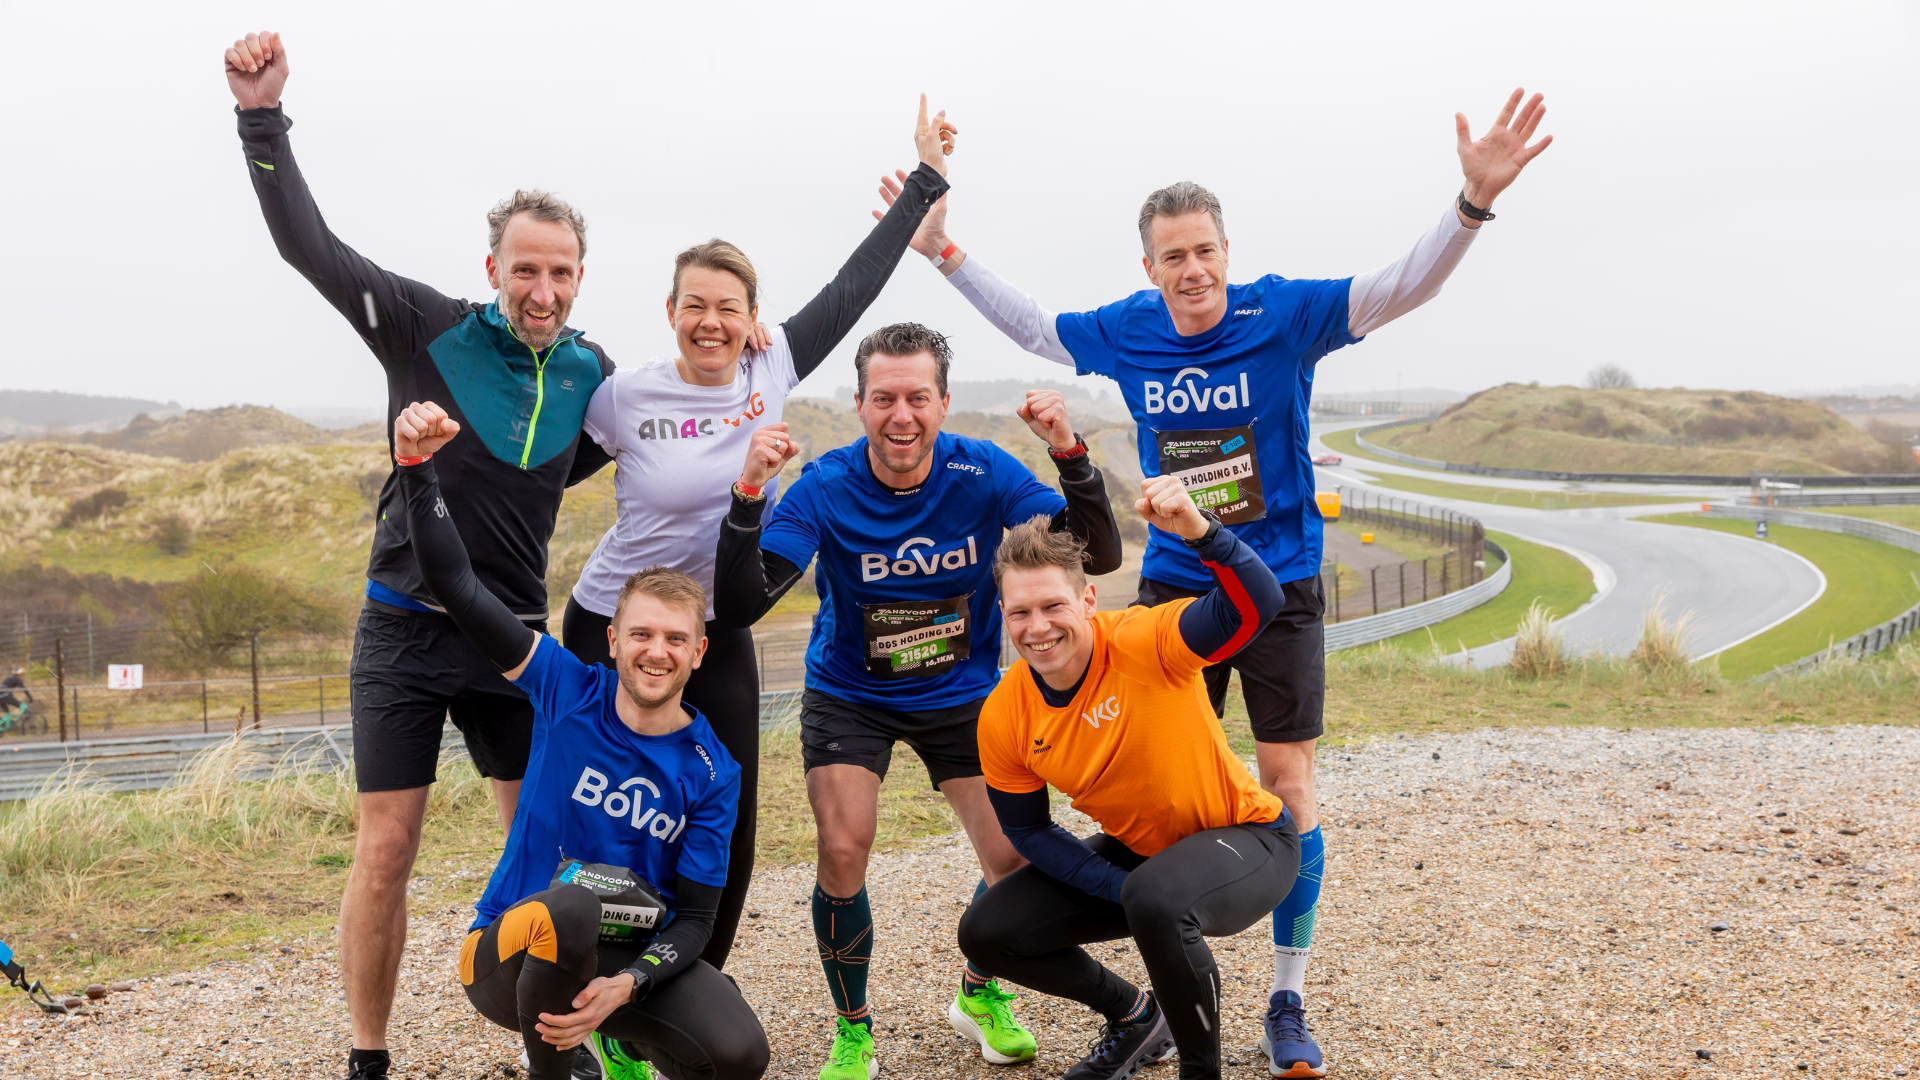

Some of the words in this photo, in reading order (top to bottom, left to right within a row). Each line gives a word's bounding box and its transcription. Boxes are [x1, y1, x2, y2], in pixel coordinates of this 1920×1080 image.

[1144, 367, 1250, 414] BoVal
[1166, 440, 1222, 448] ZANDVOORT
[947, 462, 977, 473] CRAFT
[1190, 468, 1231, 485] HOLDING
[1232, 462, 1251, 476] B.V.
[1196, 488, 1229, 508] 21515
[1220, 500, 1249, 515] 16,1KM
[861, 536, 978, 583] BoVal
[878, 640, 898, 649] D&S
[900, 628, 943, 646] HOLDING
[945, 624, 963, 634] B.V.
[900, 643, 938, 664] 21520
[925, 653, 955, 667] 16,1KM
[1082, 696, 1120, 729] VKG
[695, 744, 714, 771] CRAFT
[571, 766, 687, 843] BoVal
[575, 869, 637, 888] ZANDVOORT
[580, 878, 597, 887] CIRCUIT
[601, 910, 631, 922] DING
[633, 914, 653, 925] B.V.
